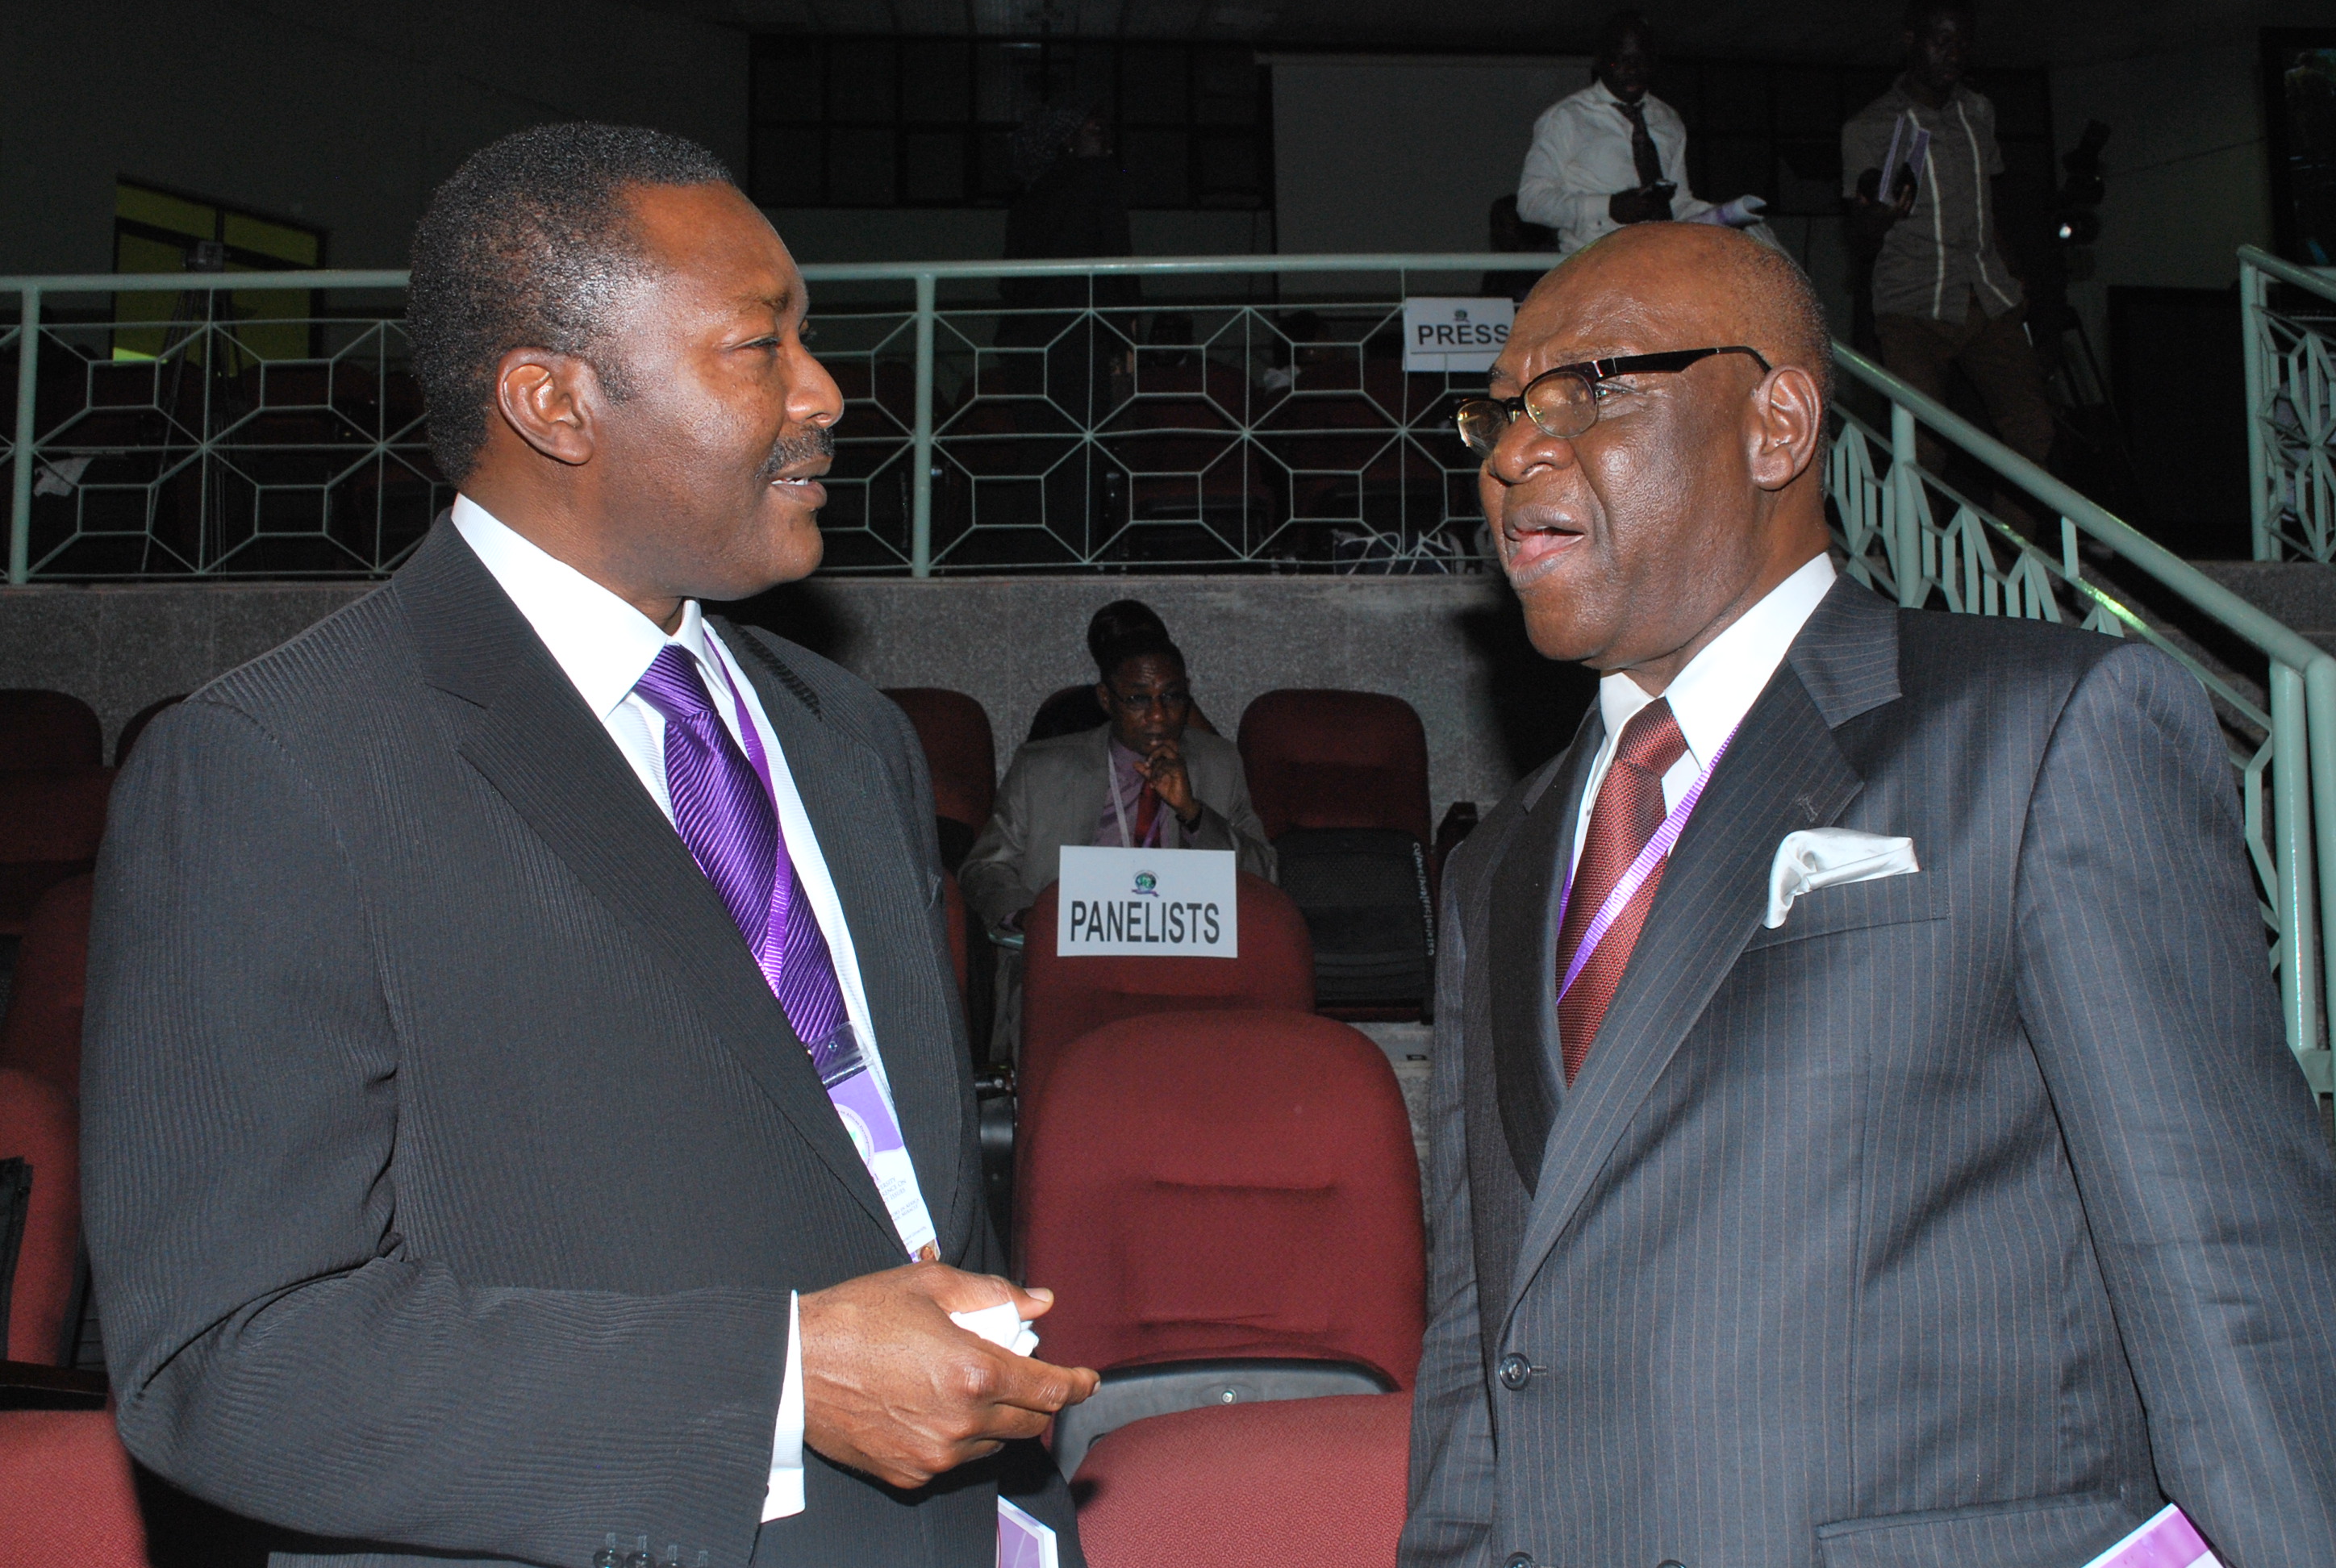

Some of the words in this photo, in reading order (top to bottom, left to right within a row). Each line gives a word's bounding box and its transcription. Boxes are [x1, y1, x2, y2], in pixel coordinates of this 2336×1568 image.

[1418, 324, 1508, 345] PRESS
[1070, 900, 1220, 945] PANELISTS
[879, 1177, 896, 1190] ERSITY
[882, 1184, 897, 1196] RENCE
